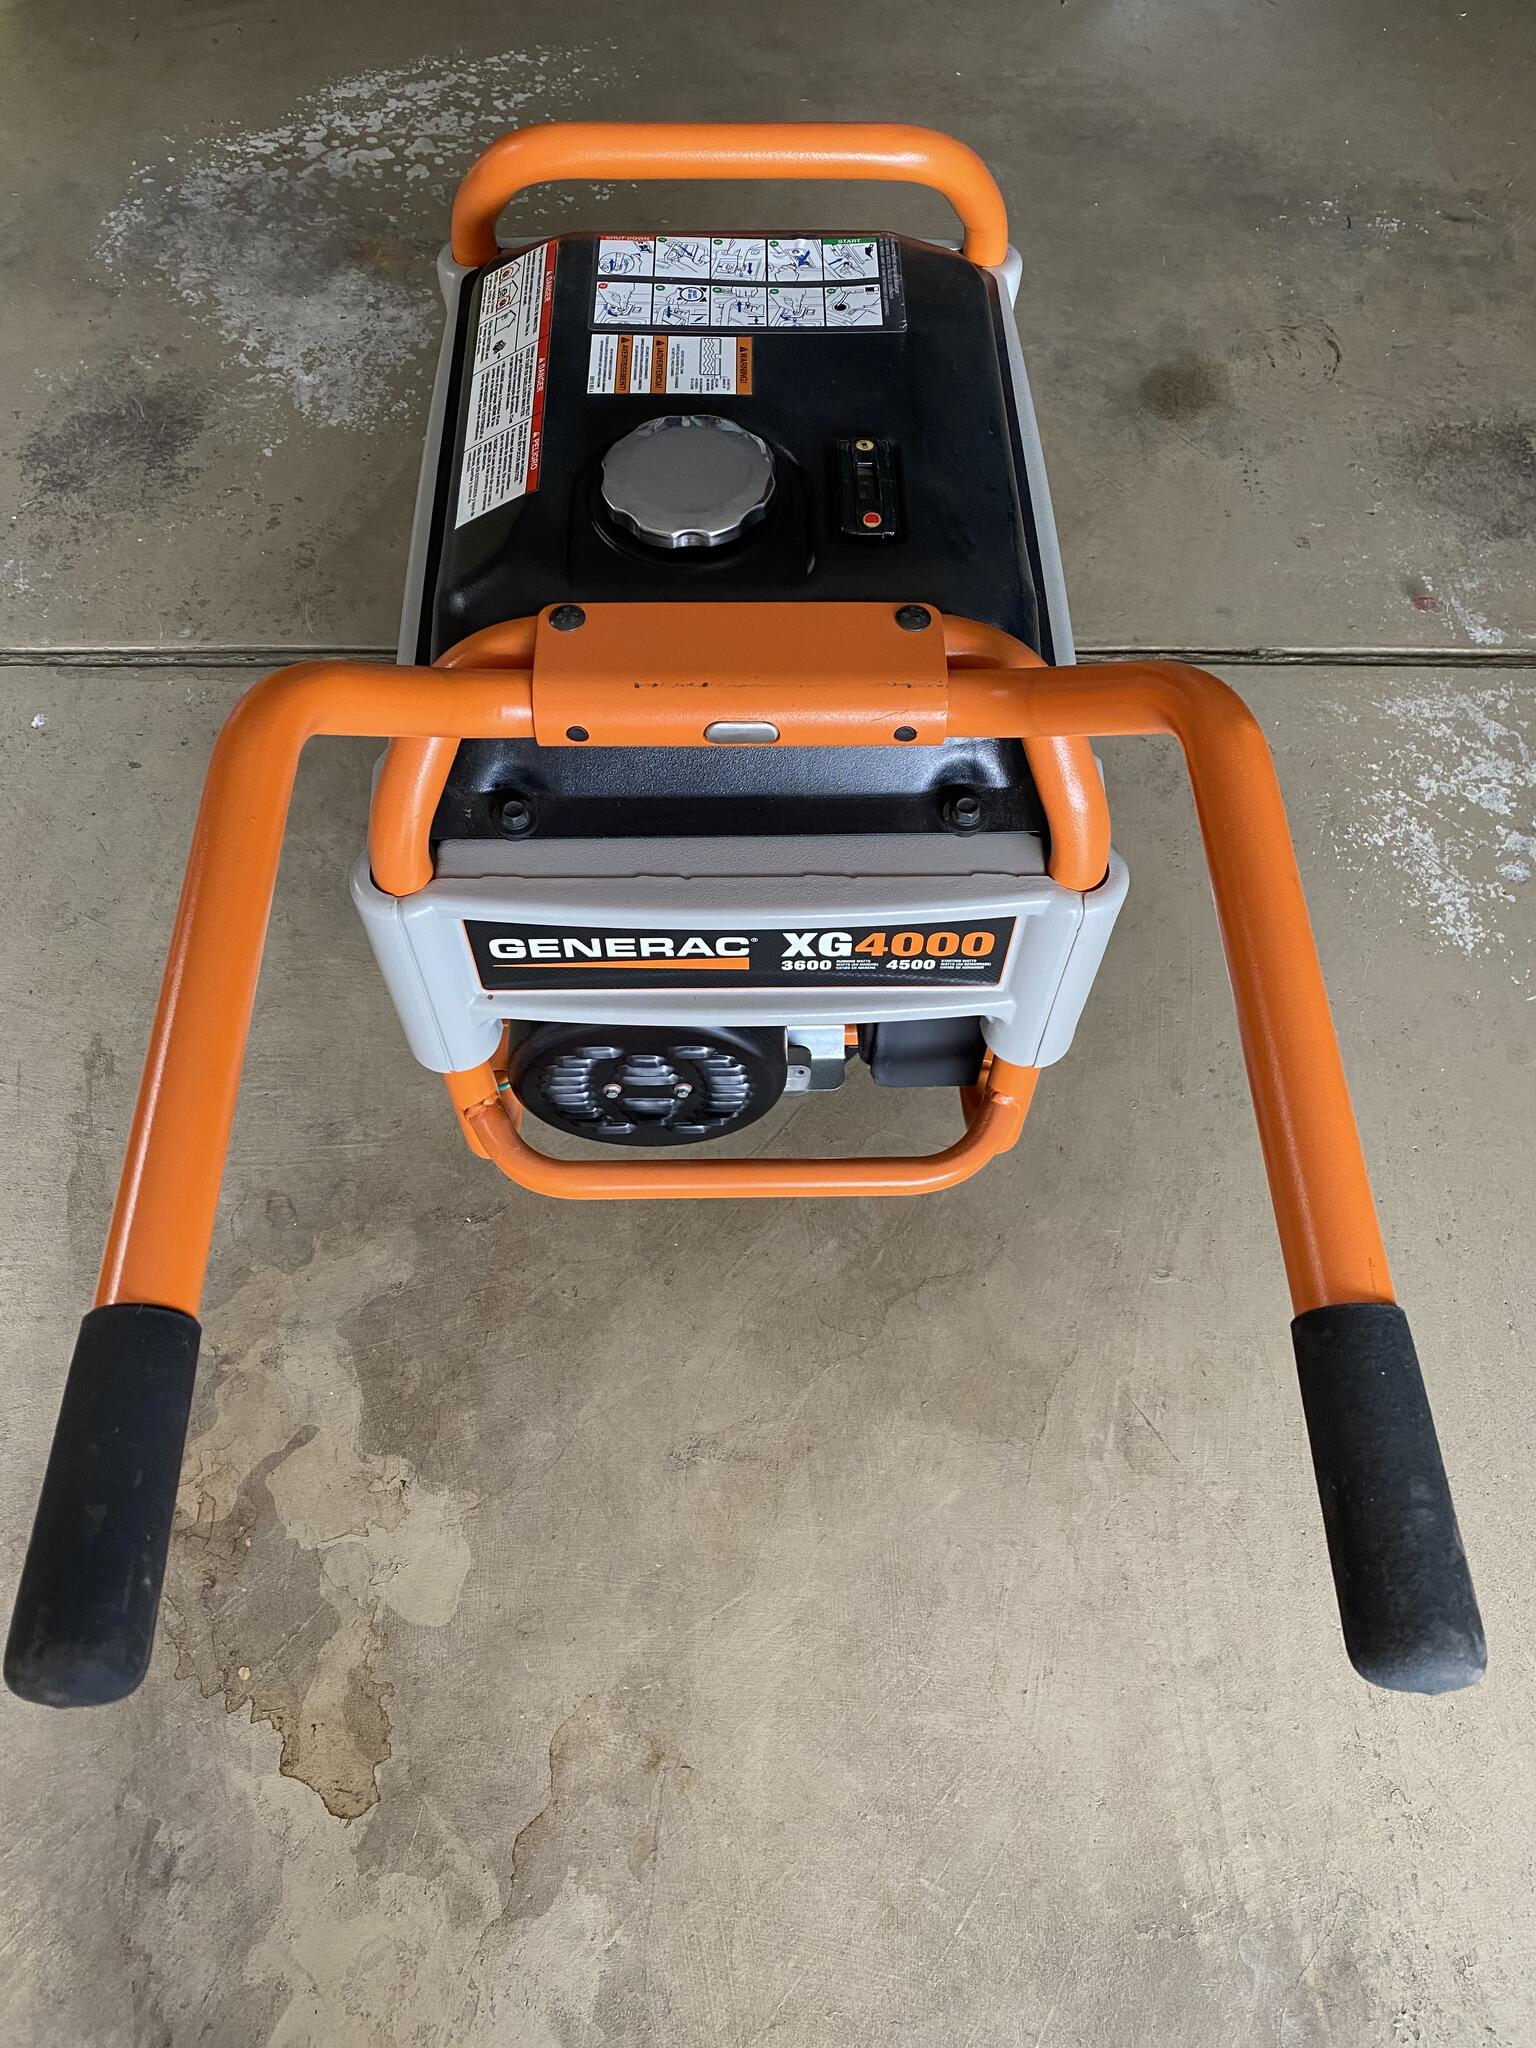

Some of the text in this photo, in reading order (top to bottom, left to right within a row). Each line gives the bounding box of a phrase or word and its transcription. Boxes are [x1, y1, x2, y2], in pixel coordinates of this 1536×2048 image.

[545, 276, 553, 302] DANGER
[537, 364, 545, 392] DANGER
[530, 437, 540, 470] PELIGRO
[488, 931, 996, 959] GENERAC XG4000
[781, 960, 832, 971] 3600
[886, 959, 936, 970] 4500
